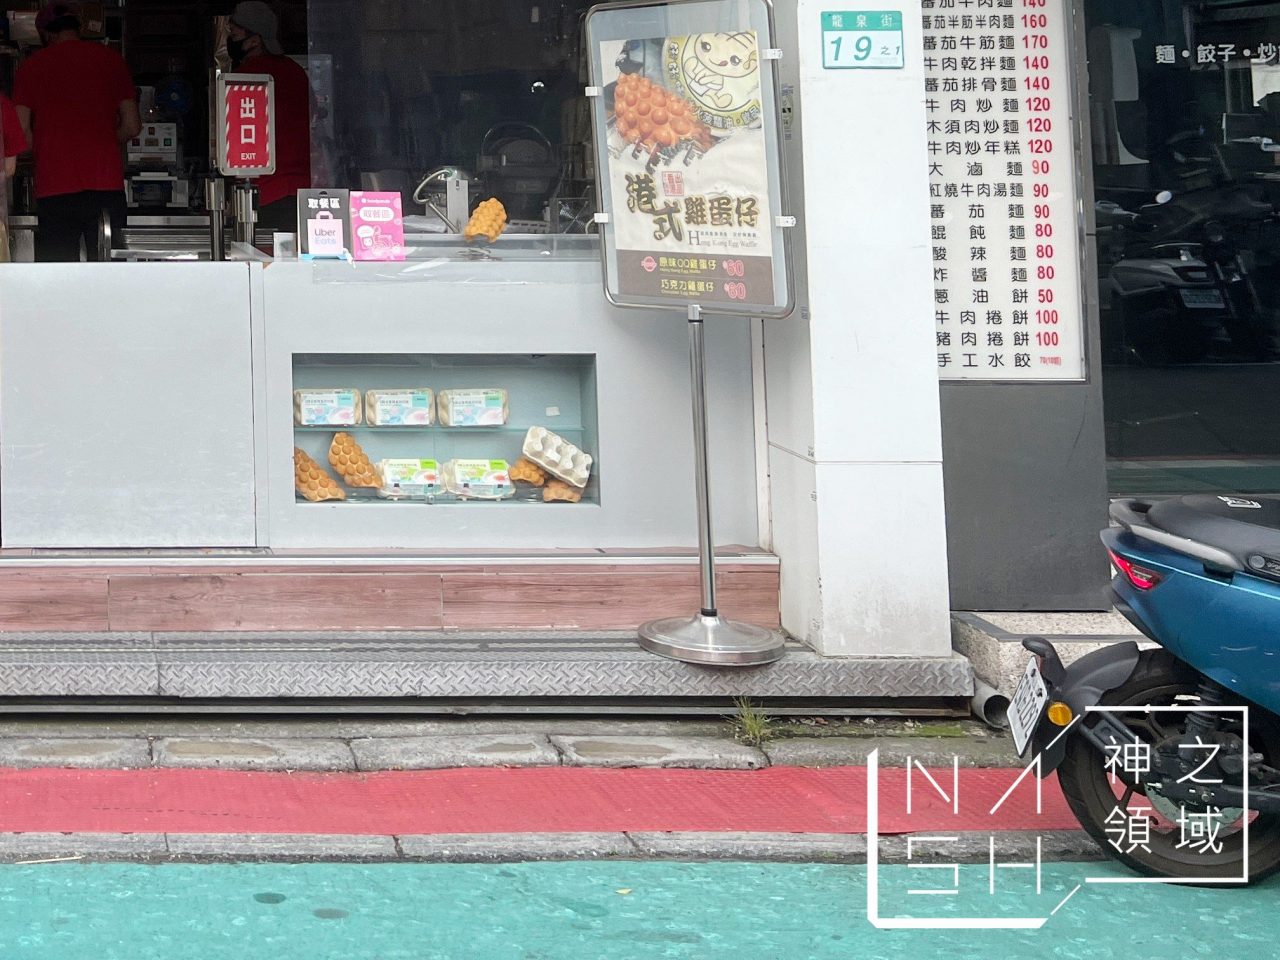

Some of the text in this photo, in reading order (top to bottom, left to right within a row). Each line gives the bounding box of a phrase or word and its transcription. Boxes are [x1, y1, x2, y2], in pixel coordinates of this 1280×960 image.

[832, 14, 892, 28] 龍泉街
[1021, 15, 1047, 28] 160
[831, 35, 872, 61] 19
[923, 35, 1048, 50] 蕃茄牛筋麵 170
[1156, 44, 1280, 65] 麵・餃子・炒
[924, 56, 1049, 71] 牛肉乾拌麵 140
[925, 77, 1050, 92] 蕃茄排骨麵 140
[925, 97, 1051, 113] 牛肉炒麵 120
[240, 97, 256, 144] 出口
[927, 118, 1052, 134] 木須肉炒麵 120
[928, 139, 1053, 155] 牛肉炒年糕 120
[929, 160, 1050, 176] 大滷麵 90
[930, 183, 1049, 198] 紅燒牛肉湯麵 90
[308, 198, 341, 208] 取餐區
[625, 173, 759, 241] 港式雞蛋仔
[930, 204, 1050, 219] 蕃茄麵 90
[314, 228, 336, 236] Uber
[931, 223, 1053, 240] 餛飩麵 80
[932, 245, 1054, 261] 酸辣麵 80
[659, 257, 717, 270] 原味QQ雞蛋仔
[933, 265, 1055, 282] 炸醬麵 80
[661, 279, 715, 291] 巧克力雞蛋仔
[1038, 289, 1053, 303] 50
[935, 310, 1058, 325] 牛肉捲餅 100
[936, 331, 1059, 347] 豬肉捲餅 100
[937, 353, 1031, 368] 手工水餃
